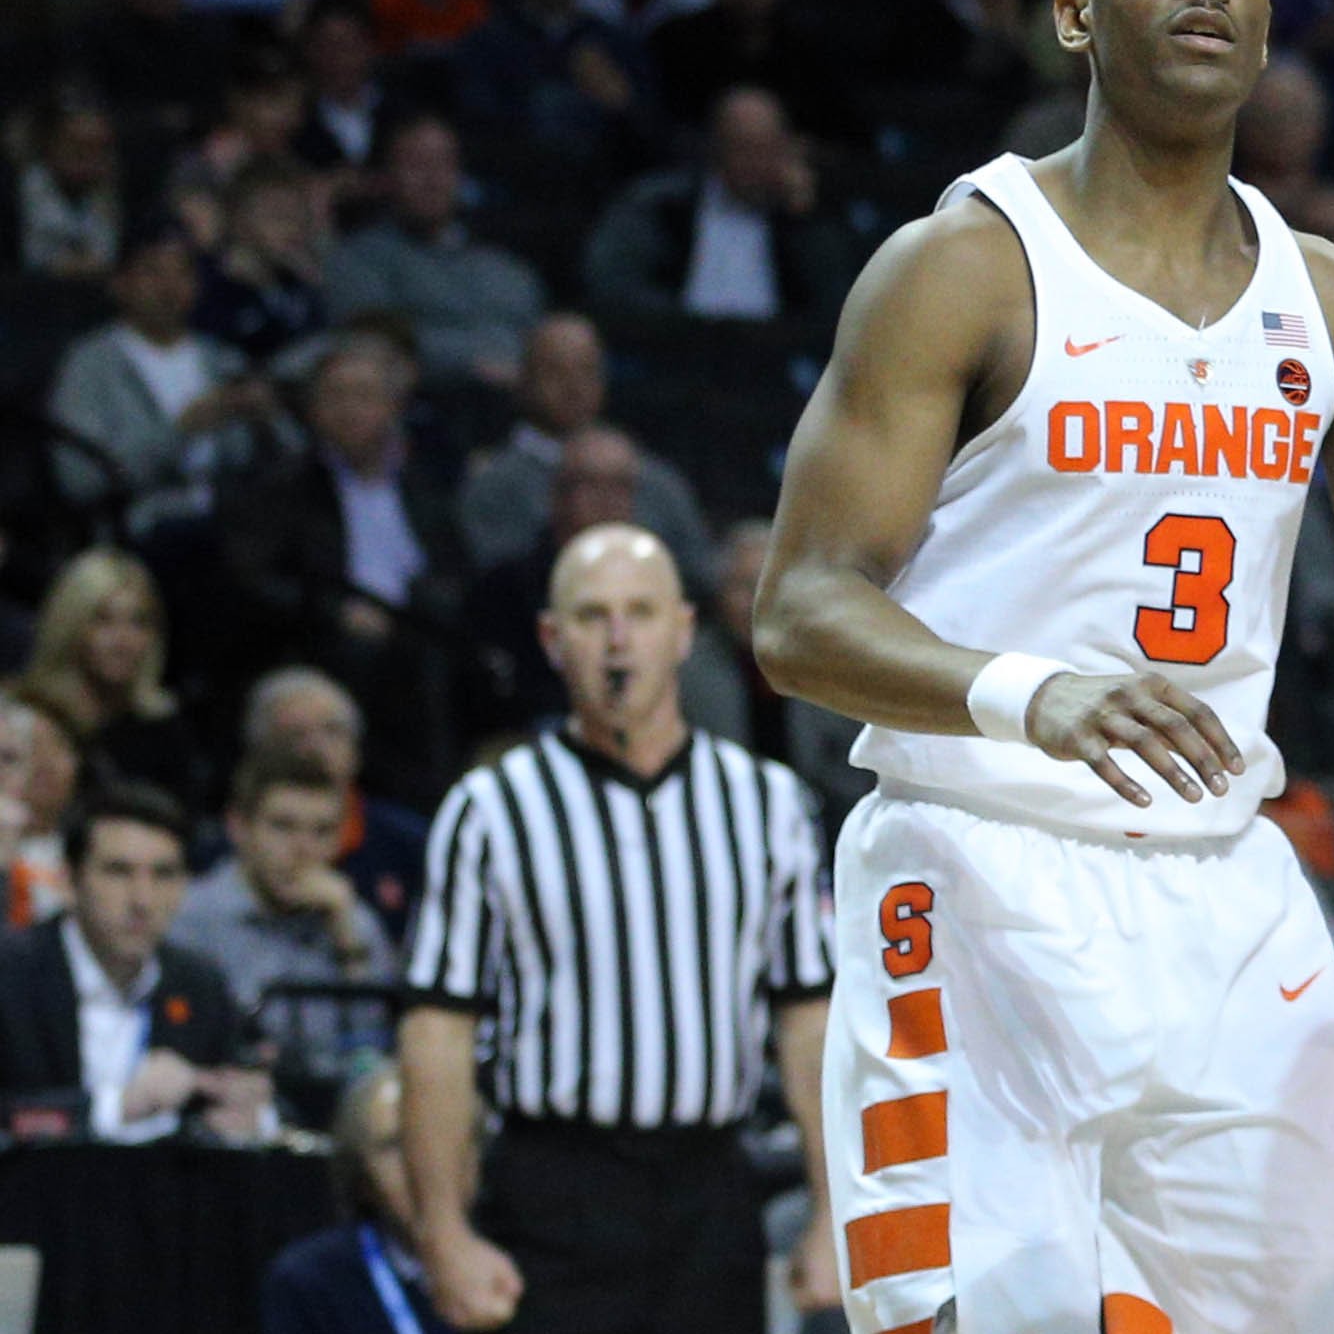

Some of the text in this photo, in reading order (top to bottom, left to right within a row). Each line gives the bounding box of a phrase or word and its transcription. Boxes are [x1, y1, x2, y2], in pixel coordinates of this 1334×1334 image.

[1046, 400, 1321, 485] ORANGE
[1133, 512, 1236, 666] 3
[879, 881, 935, 980] S
